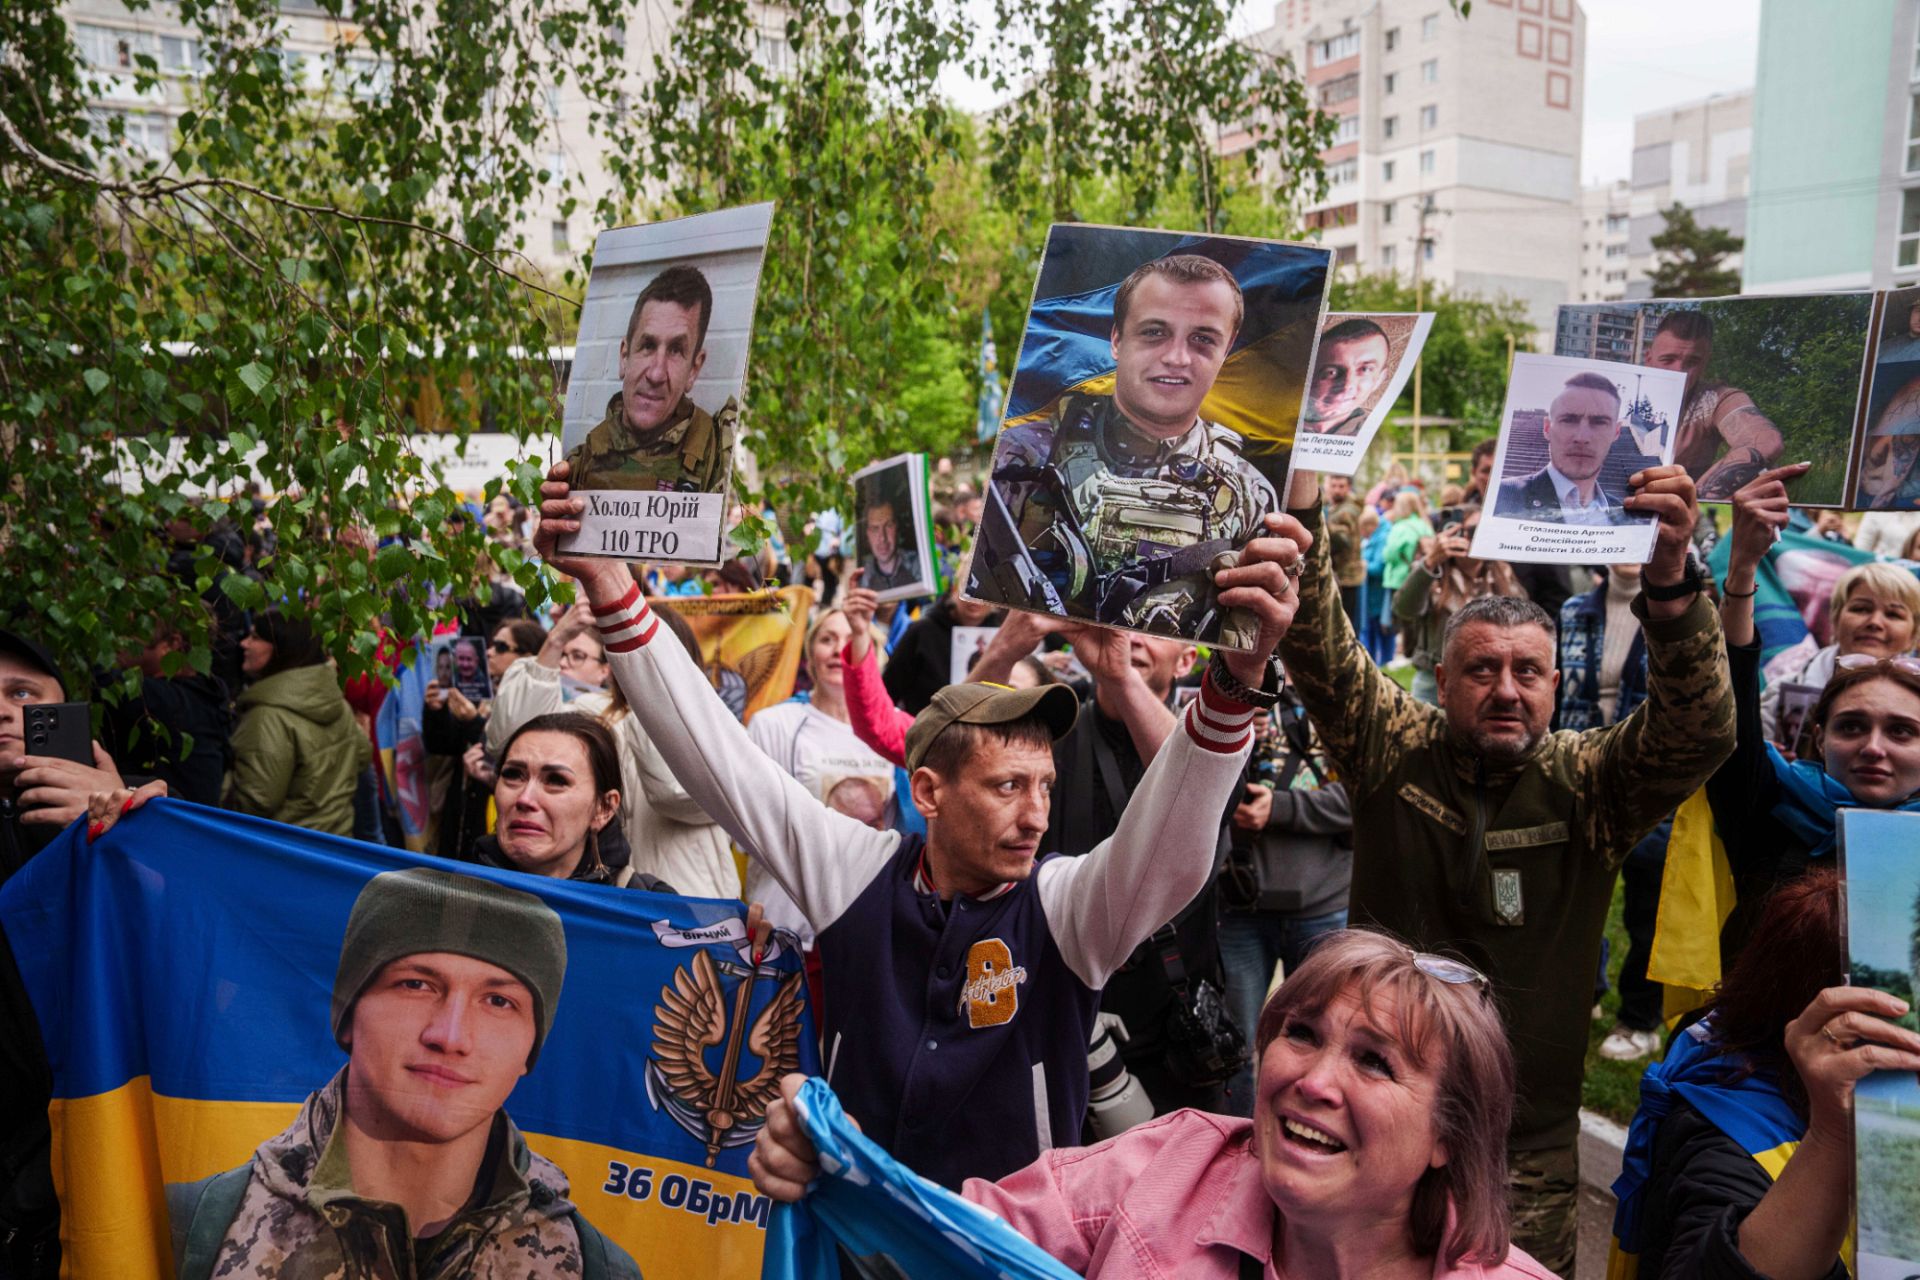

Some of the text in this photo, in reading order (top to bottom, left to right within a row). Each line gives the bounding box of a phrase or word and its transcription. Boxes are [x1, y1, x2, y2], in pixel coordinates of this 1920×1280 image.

[588, 495, 700, 524] Холод Юрій
[601, 529, 679, 555] 110 ТРО
[1498, 542, 1626, 554] Зник безвісти 16.09.2022
[1531, 535, 1596, 545] Олексійович
[603, 1160, 654, 1201] 36
